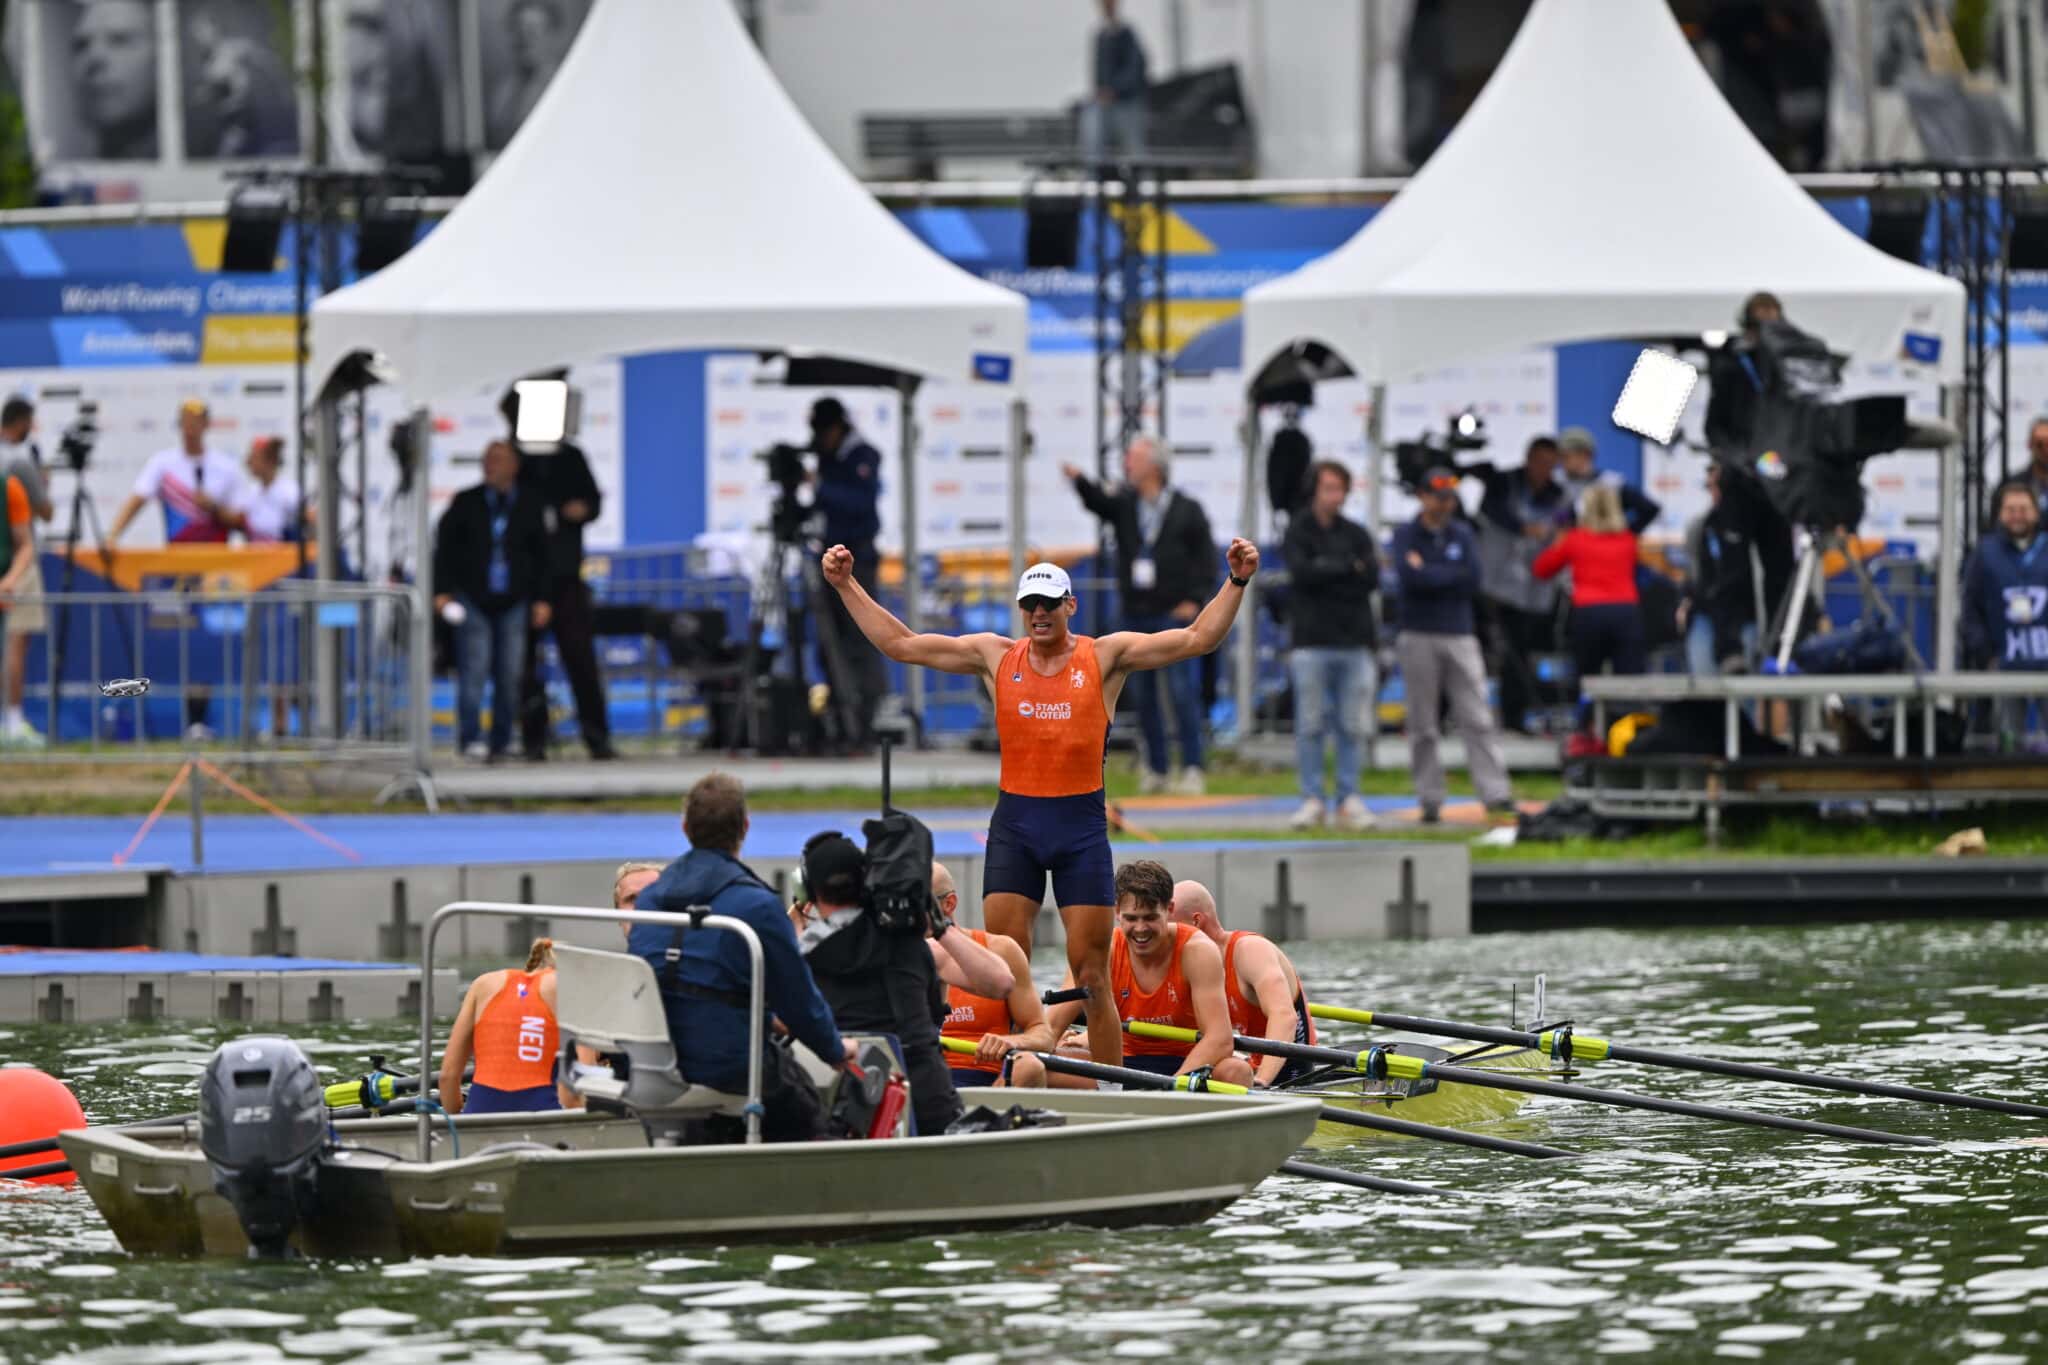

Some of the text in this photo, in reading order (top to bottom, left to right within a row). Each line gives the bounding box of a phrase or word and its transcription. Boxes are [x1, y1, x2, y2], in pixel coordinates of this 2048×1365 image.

[61, 285, 121, 312] World
[123, 283, 199, 316] Rowing
[1035, 702, 1072, 712] STAATS
[518, 1016, 545, 1062] NED
[233, 1106, 272, 1124] 25
